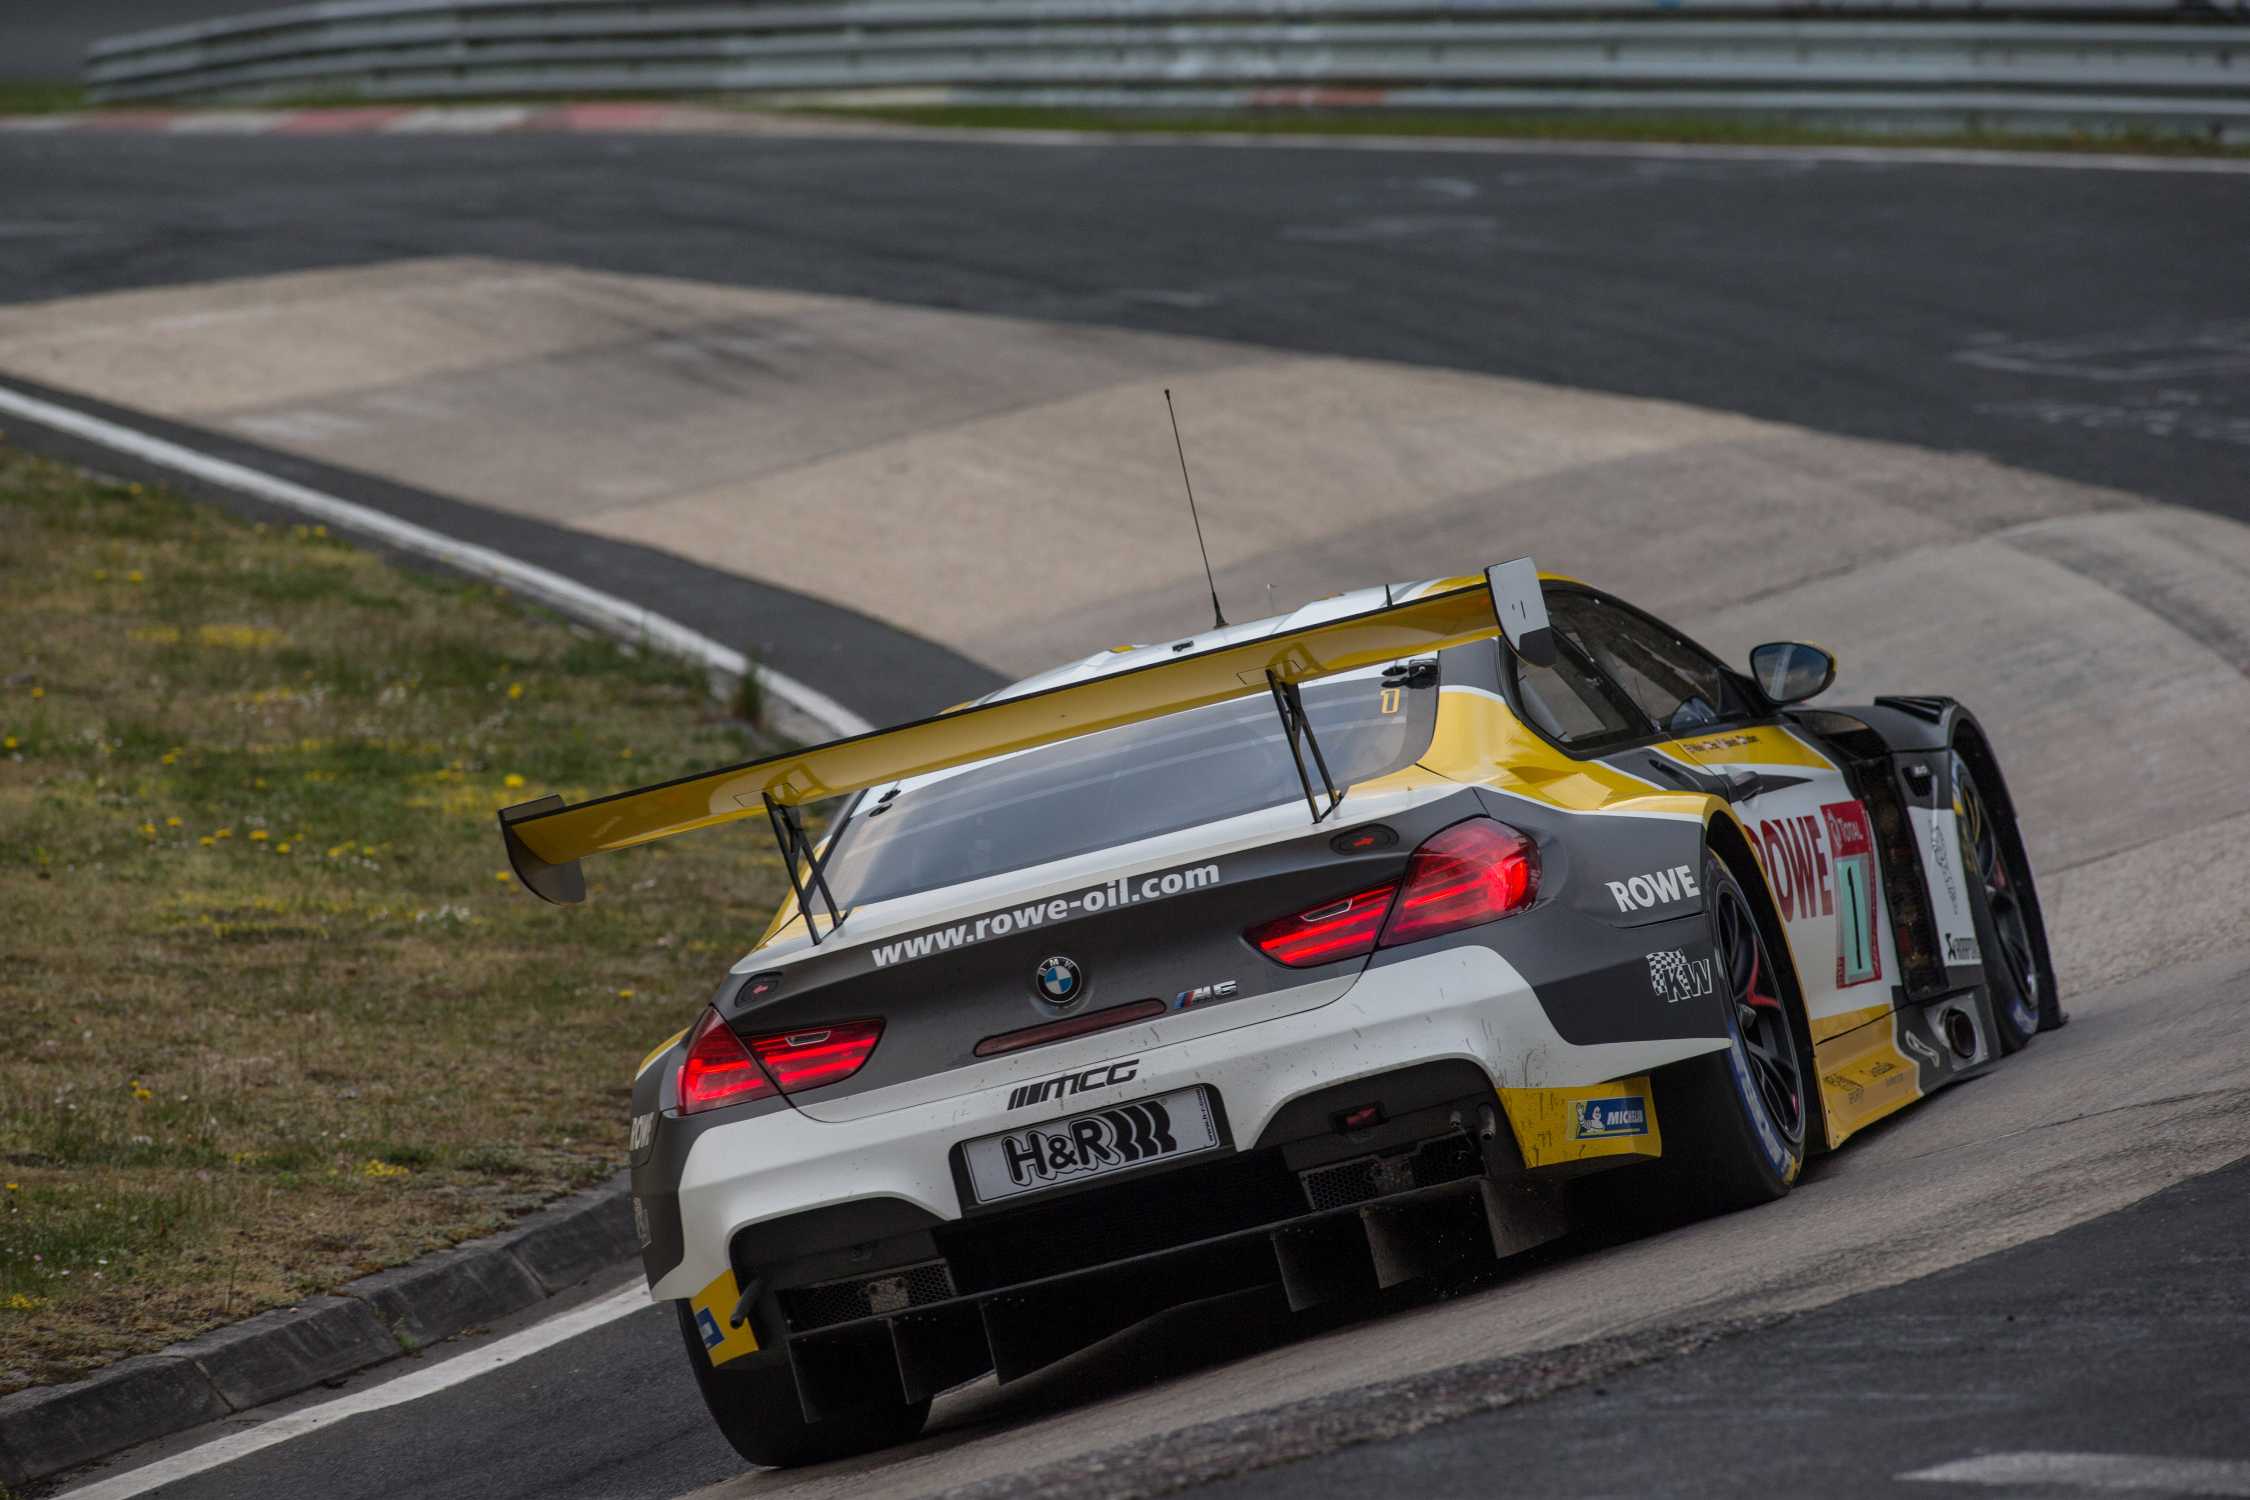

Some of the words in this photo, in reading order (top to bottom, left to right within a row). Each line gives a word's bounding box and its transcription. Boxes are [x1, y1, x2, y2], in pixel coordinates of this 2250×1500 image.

[871, 863, 1220, 968] www.rowe-oil.com
[1604, 864, 1701, 913] ROWE
[1660, 958, 1713, 1003] KW
[1002, 1117, 1116, 1183] H&R
